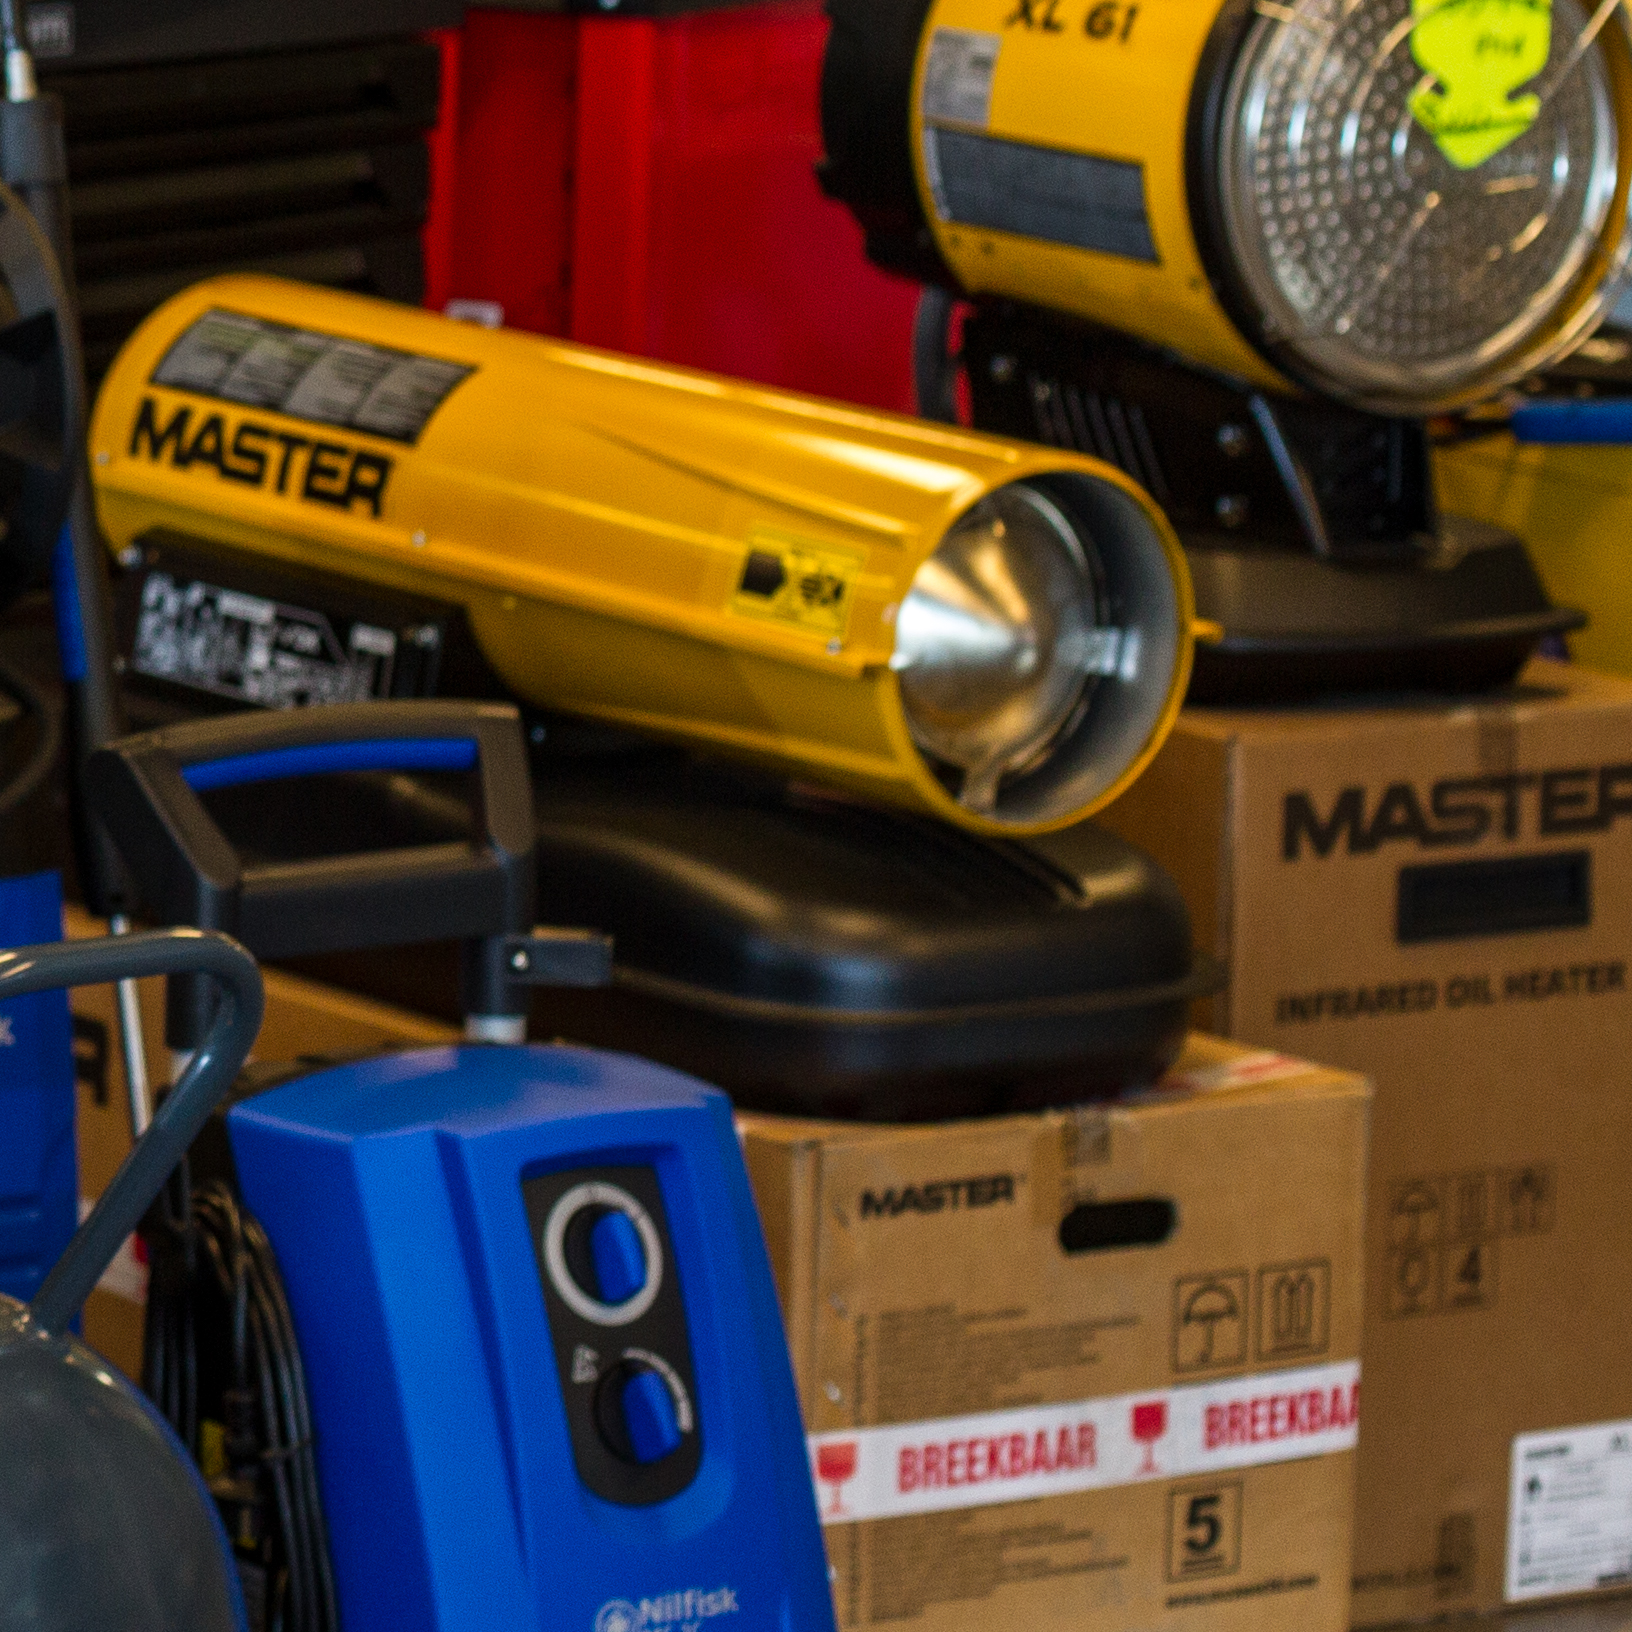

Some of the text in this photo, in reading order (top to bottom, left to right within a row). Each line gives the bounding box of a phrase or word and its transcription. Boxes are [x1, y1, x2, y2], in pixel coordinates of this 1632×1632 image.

[1085, 1, 1140, 46] 61
[130, 397, 395, 519] MASTER
[1282, 766, 1632, 862] MASTER
[1277, 963, 1626, 1025] INFRARED OIL HEATER
[860, 1176, 1016, 1222] MASTER
[1203, 1382, 1360, 1450] BREEKBAA
[898, 1423, 1097, 1494] BREEKBAAR
[1185, 1495, 1221, 1553] 5
[639, 1586, 739, 1623] Nilfisk
